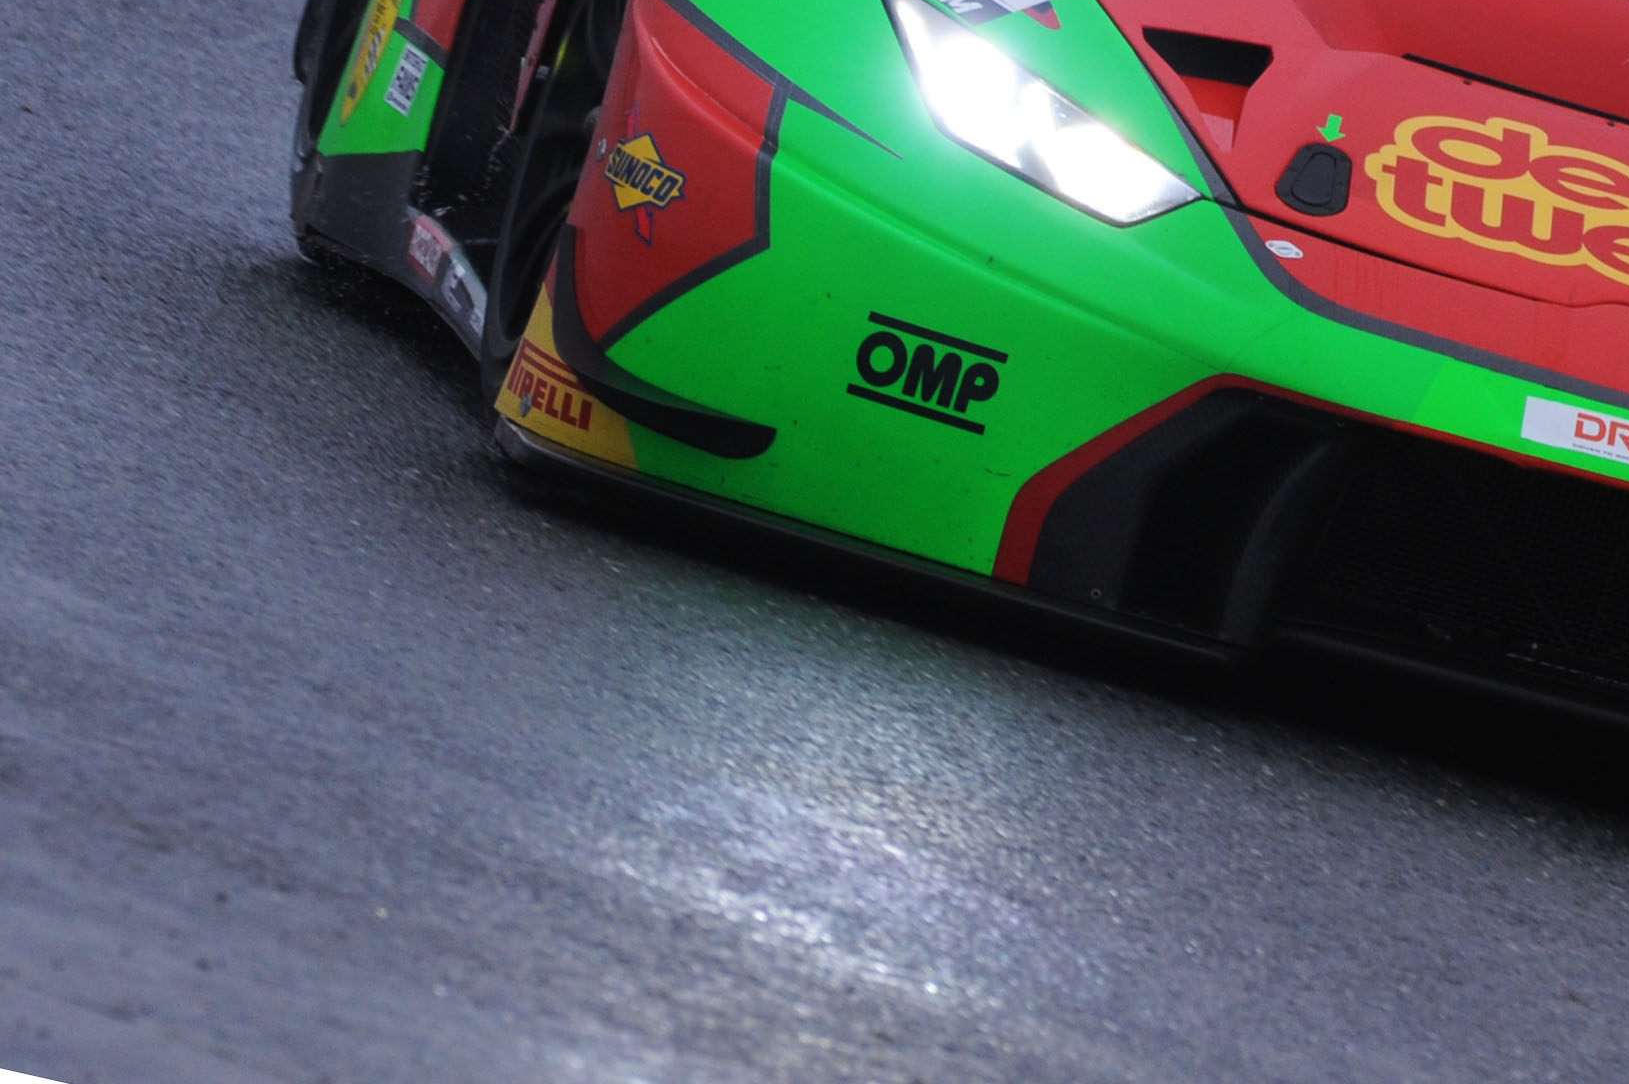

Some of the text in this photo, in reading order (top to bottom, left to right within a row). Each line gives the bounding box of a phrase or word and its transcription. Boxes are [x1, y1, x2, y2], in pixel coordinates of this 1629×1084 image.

[605, 146, 681, 203] SUNOCO
[506, 337, 593, 432] PIRELLI
[855, 330, 1001, 414] OMP
